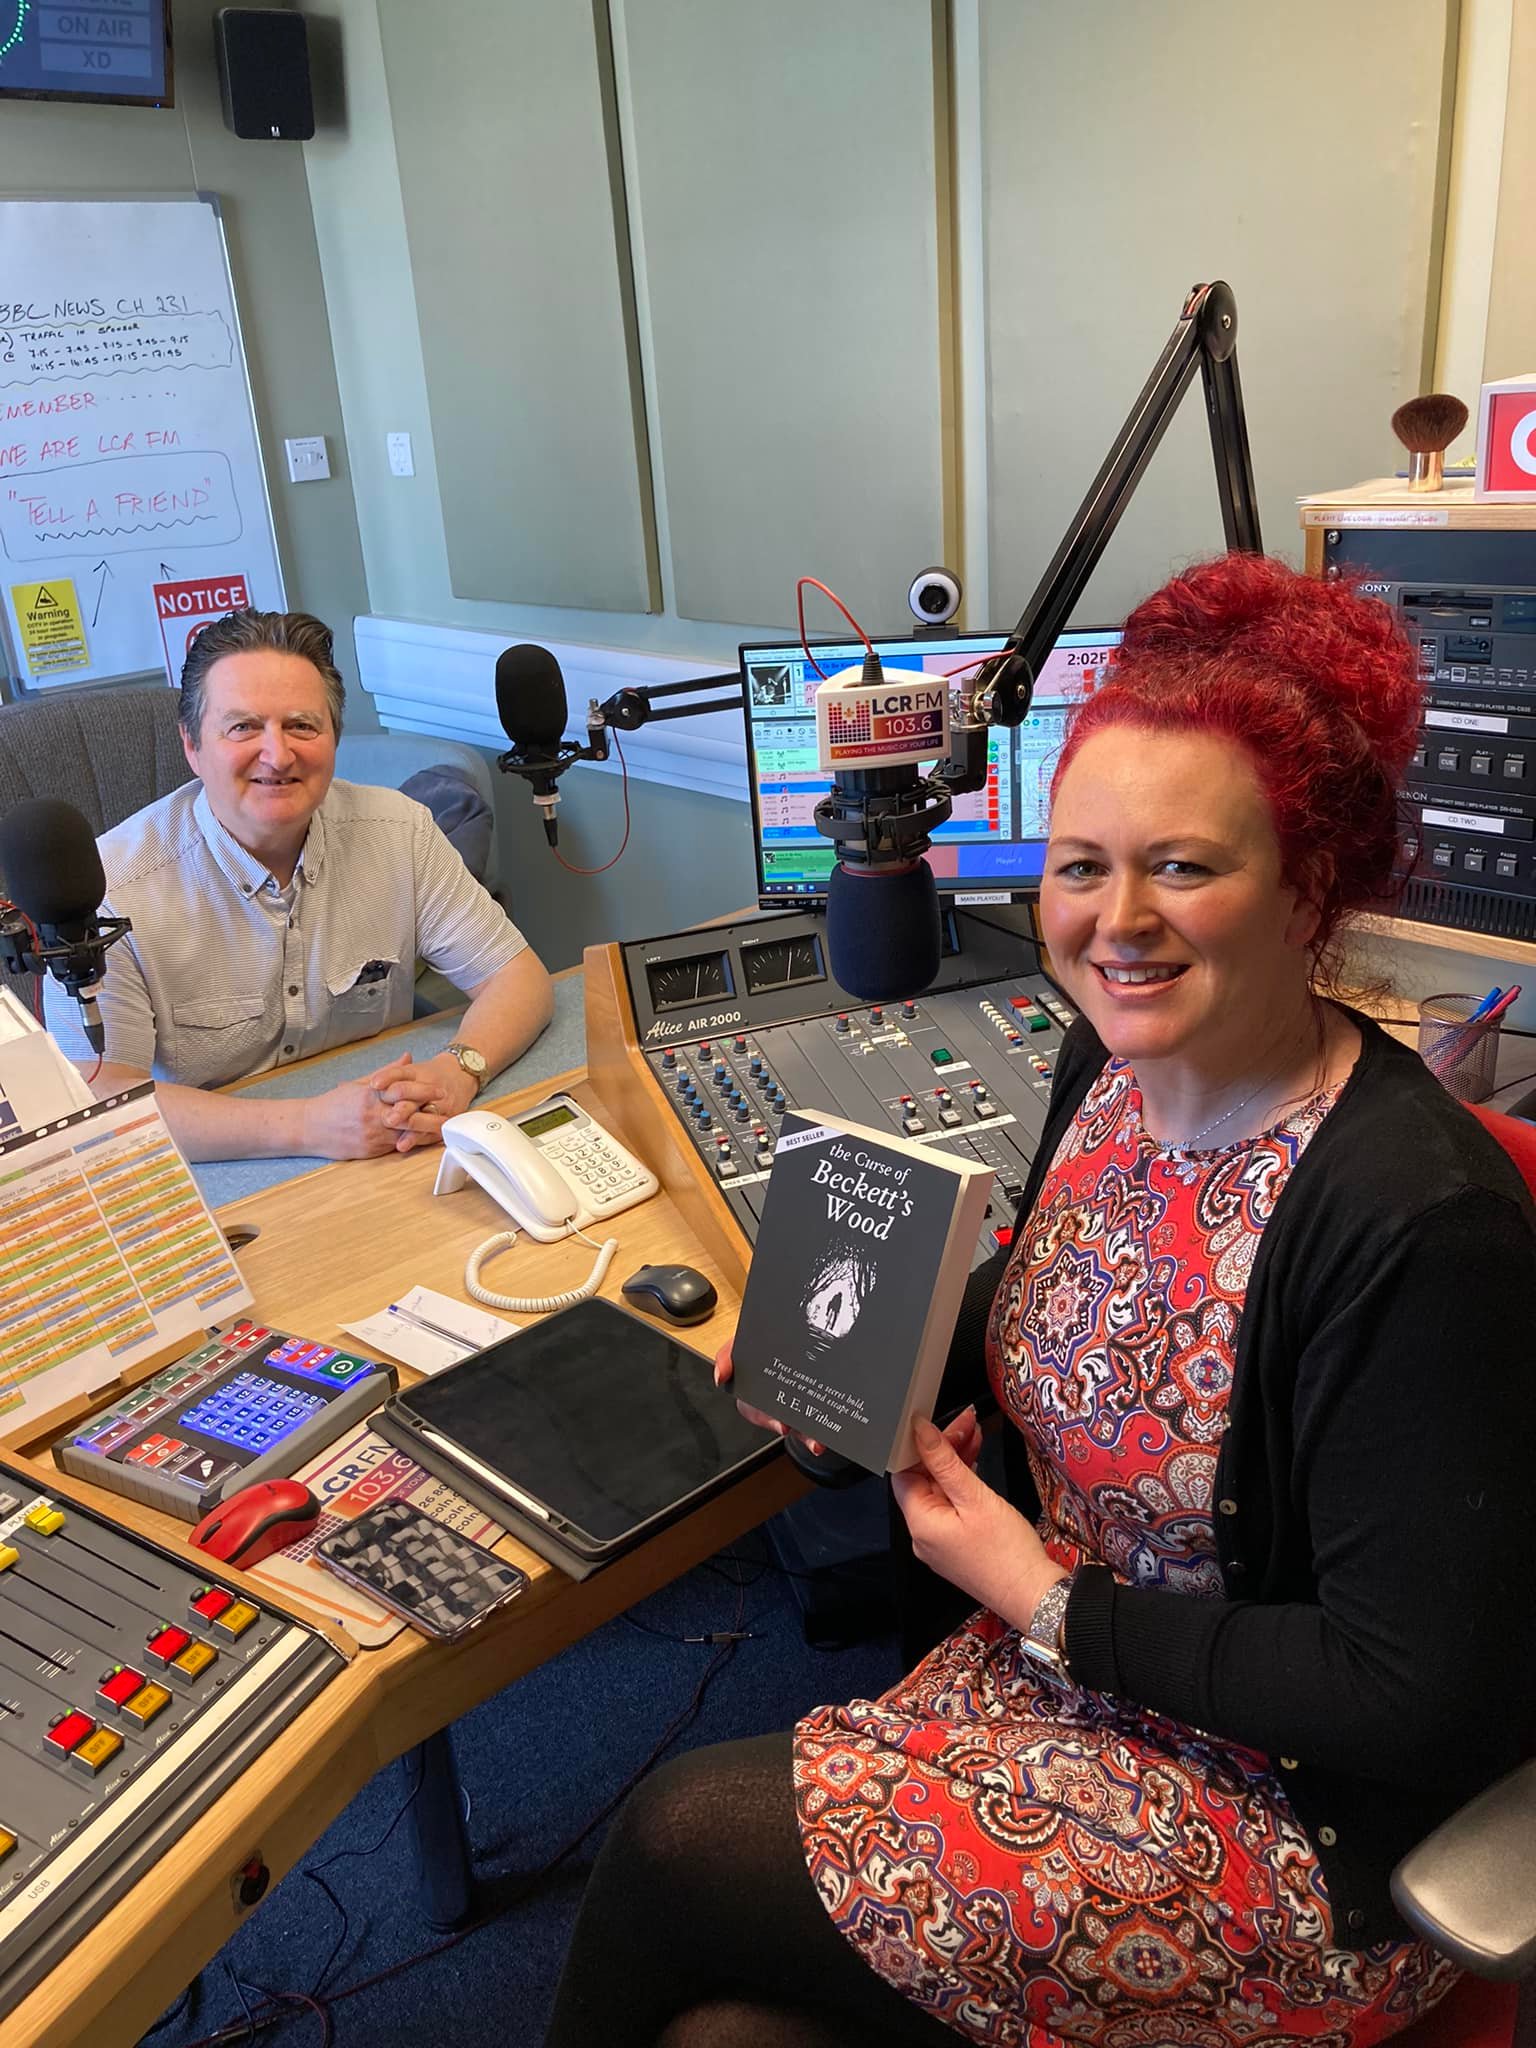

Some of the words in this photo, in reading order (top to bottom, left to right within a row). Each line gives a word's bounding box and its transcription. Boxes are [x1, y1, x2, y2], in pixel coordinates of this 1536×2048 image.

[57, 15, 90, 35] ON
[96, 18, 133, 38] AIR
[81, 48, 112, 69] XD
[54, 298, 105, 319] NEWS
[116, 298, 145, 314] CH
[156, 295, 188, 313] 231
[40, 436, 81, 461] ARE
[98, 432, 137, 454] LCR
[145, 430, 181, 446] FM
[86, 499, 101, 523] A
[1359, 583, 1391, 593] SONY
[158, 585, 246, 616] NOTICE
[26, 608, 70, 621] Warning
[872, 695, 913, 715] LCR
[915, 690, 943, 710] FM
[885, 714, 932, 735] 103.6
[1463, 718, 1479, 726] ONE
[834, 748, 863, 756] PLAYING
[878, 743, 899, 752] MUSIC
[908, 740, 926, 749] YOUR
[926, 738, 939, 746] LIFE
[1460, 817, 1477, 826] TWO
[645, 1020, 684, 1041] Alice
[687, 1018, 708, 1032] AIR
[710, 1011, 741, 1027] 2000
[785, 1136, 801, 1147] BEST
[801, 1130, 825, 1142] SELLER
[829, 1143, 852, 1161] the
[854, 1151, 893, 1176] Curse
[894, 1168, 912, 1186] of
[810, 1159, 914, 1217] Beckett's
[825, 1193, 896, 1241] Wood
[255, 1377, 266, 1387] 17
[289, 1389, 301, 1398] 19
[305, 1395, 318, 1405] 20
[763, 1367, 777, 1377] nor
[776, 1371, 798, 1388] heart
[797, 1383, 807, 1392] or
[806, 1387, 828, 1403] mind
[826, 1398, 850, 1415] escape
[850, 1408, 870, 1425] them
[772, 1357, 793, 1374] Trees
[793, 1369, 818, 1386] cannot
[817, 1382, 824, 1390] a
[824, 1385, 846, 1401] secret
[846, 1393, 865, 1412] hold,
[222, 1384, 233, 1393] 11
[238, 1390, 250, 1399] 12
[255, 1395, 268, 1405] 13
[271, 1401, 284, 1411] 14
[288, 1407, 301, 1417] 15
[272, 1420, 285, 1430] 10
[804, 1404, 843, 1433] Witham
[350, 1454, 414, 1504] 103.6
[405, 1471, 426, 1490] YOUR
[418, 1493, 436, 1509] 26
[138, 1693, 155, 1708] OFF
[89, 1738, 106, 1754] OFF
[27, 1879, 51, 1900] USB
